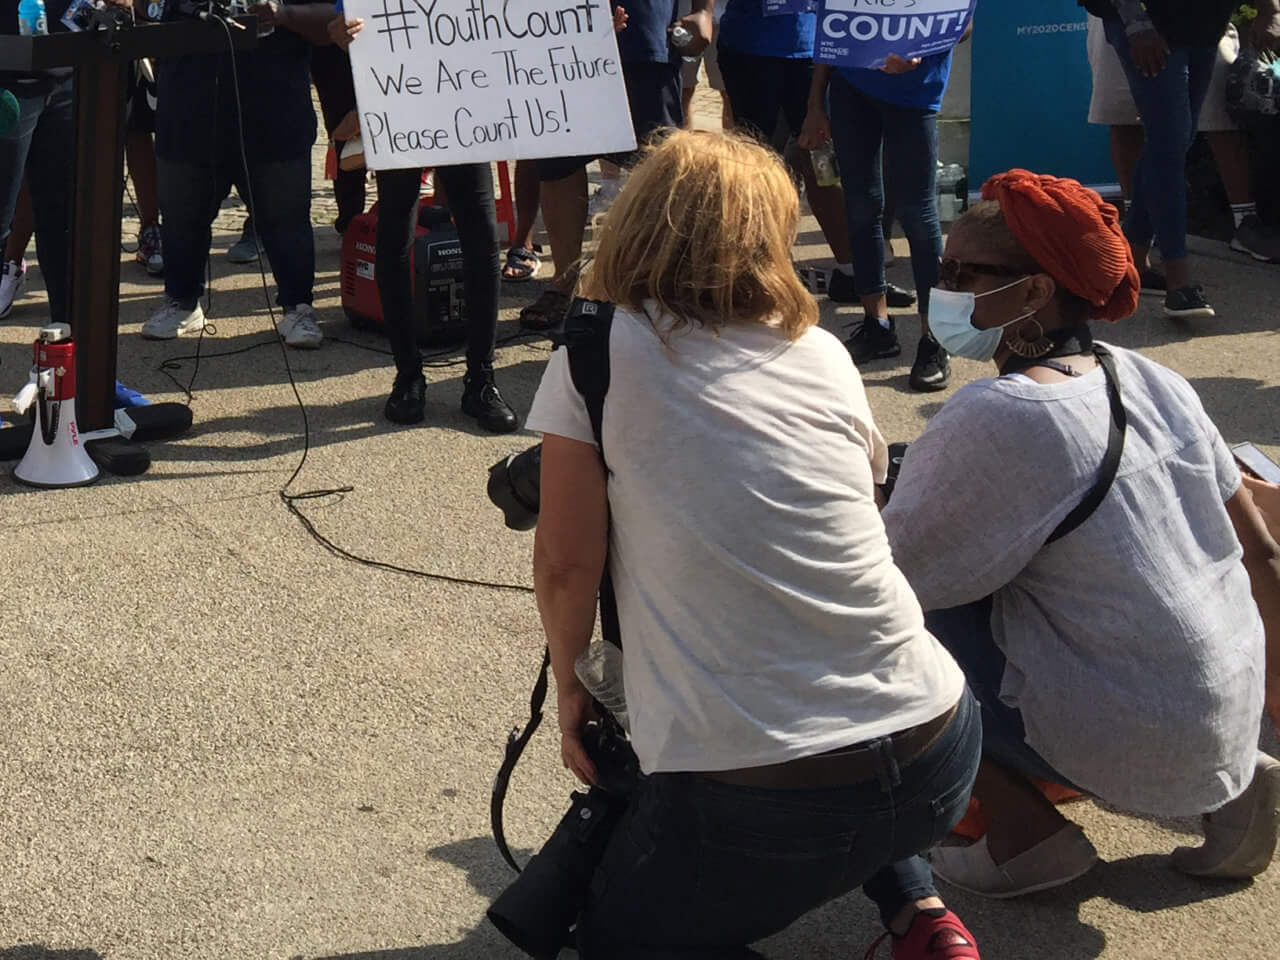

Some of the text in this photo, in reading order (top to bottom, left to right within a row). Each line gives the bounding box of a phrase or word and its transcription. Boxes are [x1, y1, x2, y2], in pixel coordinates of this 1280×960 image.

[822, 11, 969, 42] COUNT!
[1016, 21, 1088, 36] MY2020CENS
[371, 45, 618, 96] We Are The Future
[364, 89, 571, 155] Please Count Us!
